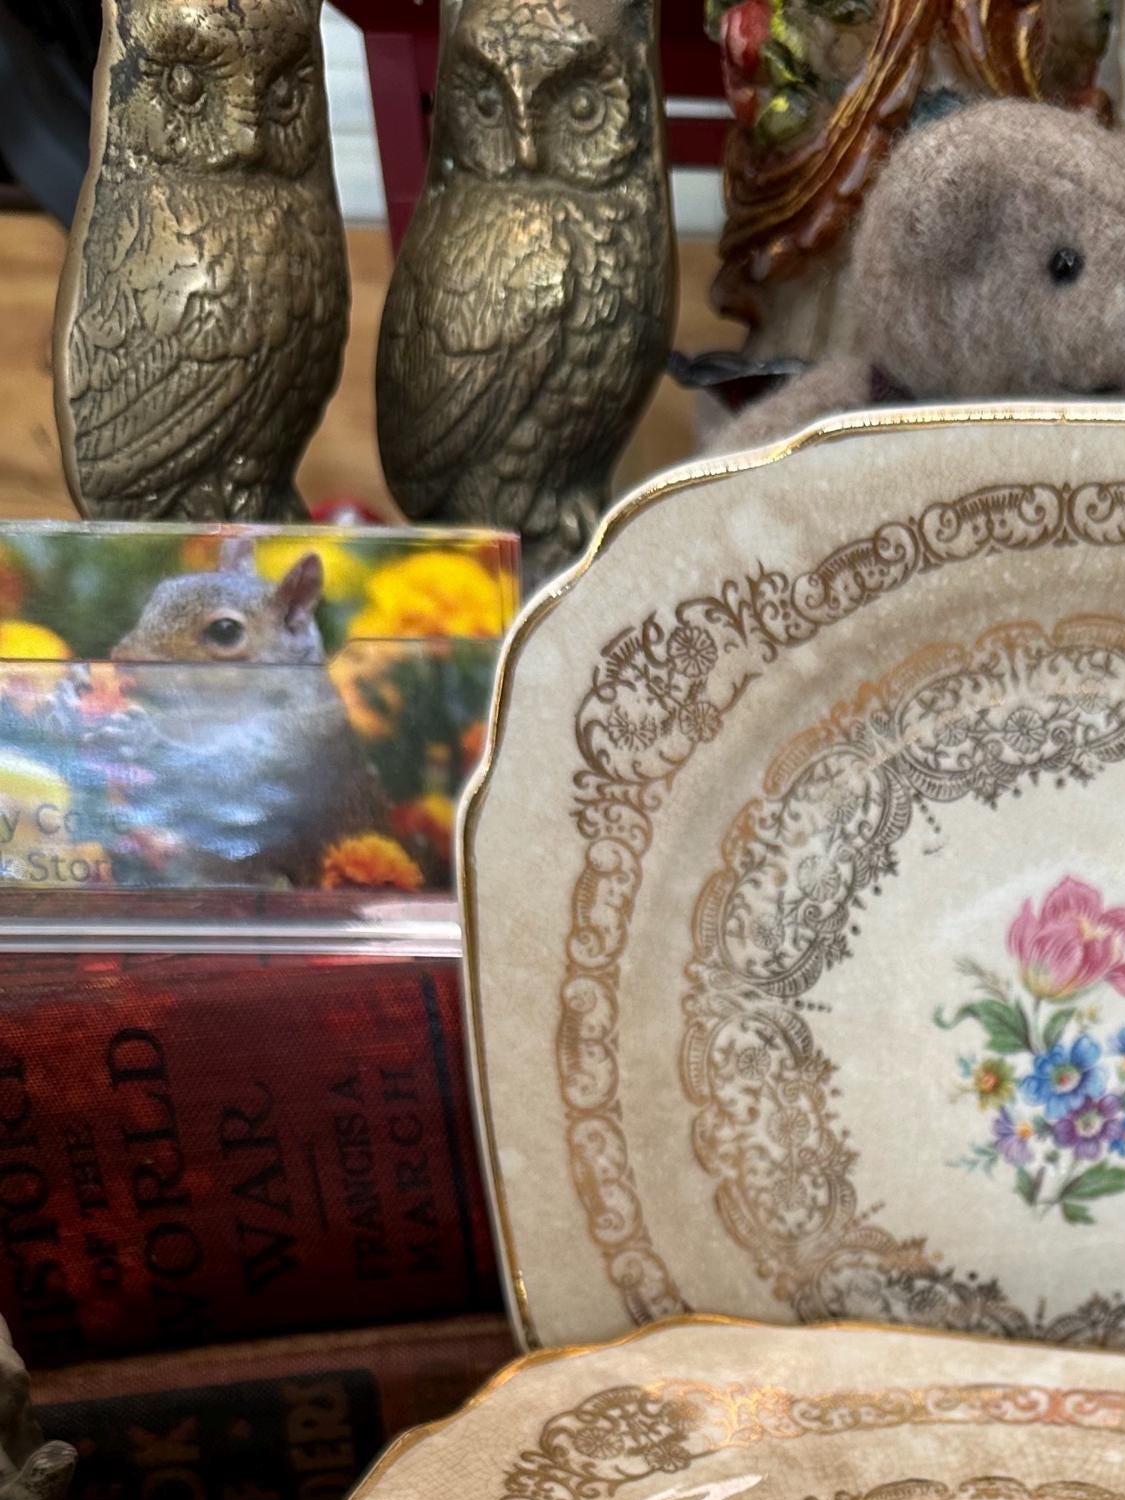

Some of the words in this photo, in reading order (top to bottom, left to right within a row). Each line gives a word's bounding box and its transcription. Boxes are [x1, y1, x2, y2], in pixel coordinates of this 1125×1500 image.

[106, 1028, 212, 1344] WORLD
[217, 1081, 300, 1294] WAR
[334, 1113, 394, 1280] FRANCIS
[380, 1067, 447, 1275] MARCH
